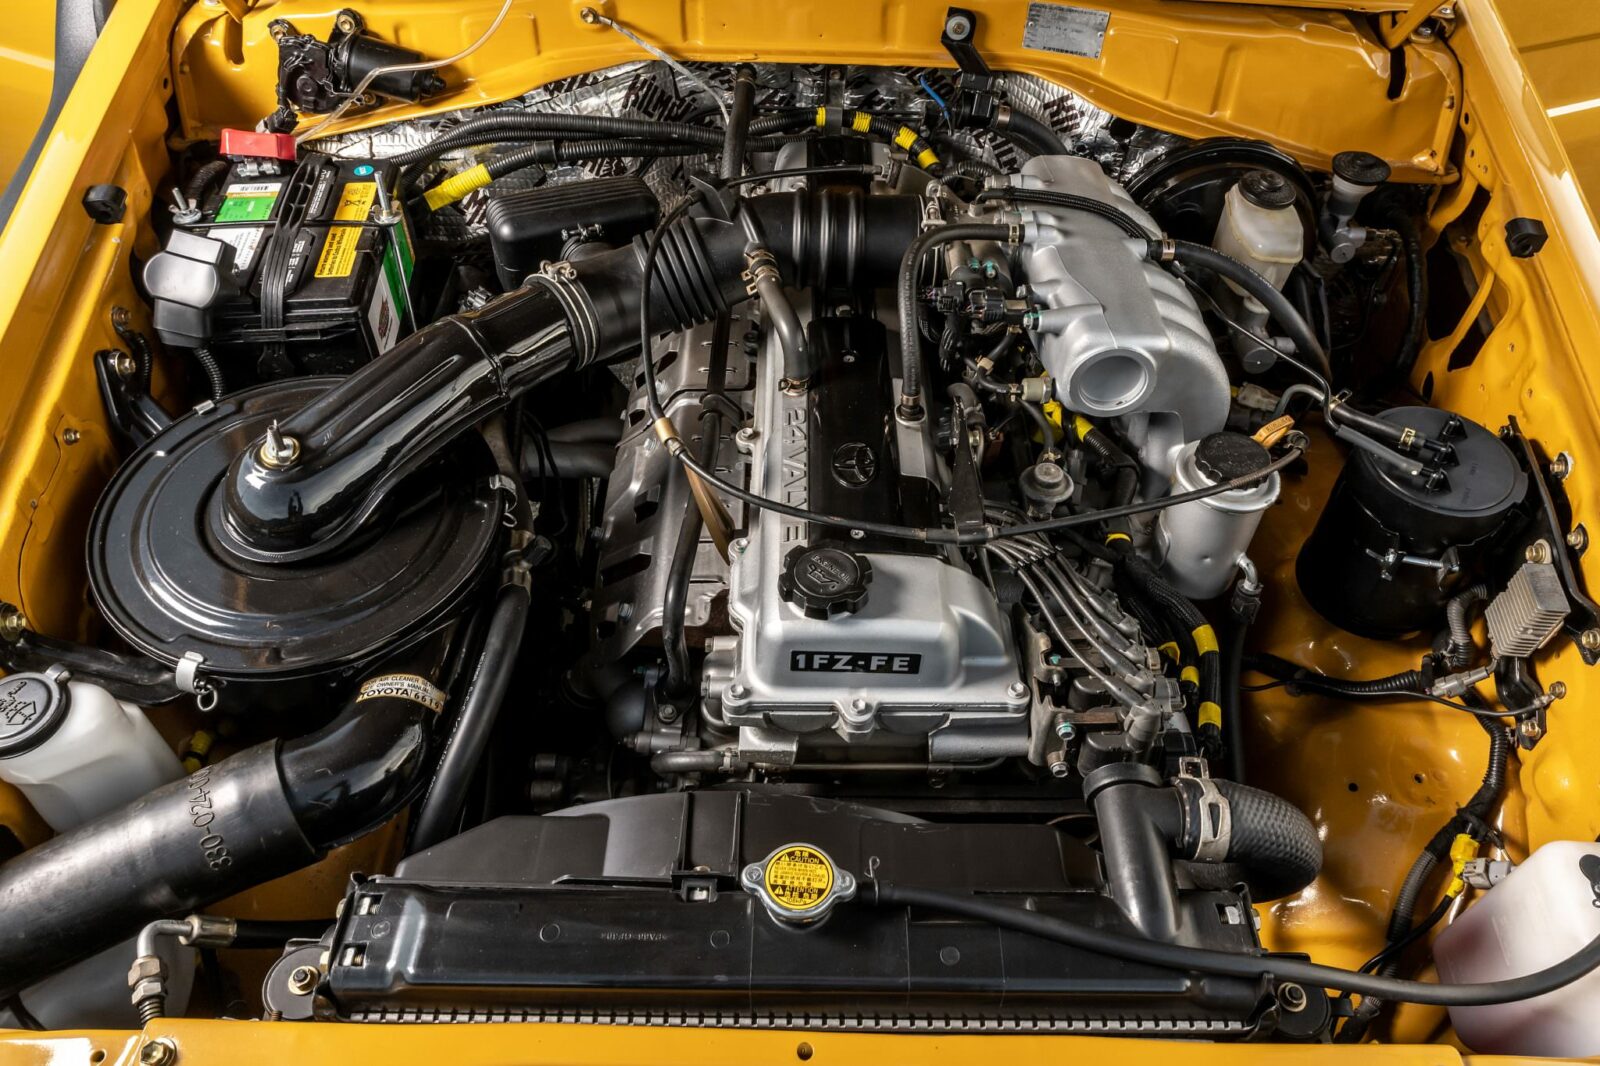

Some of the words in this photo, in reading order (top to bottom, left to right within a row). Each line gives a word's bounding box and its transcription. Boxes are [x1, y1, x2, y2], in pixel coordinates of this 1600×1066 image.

[796, 653, 911, 672] 1FZ-FE
[360, 687, 410, 699] TOYOTA
[786, 886, 819, 894] ATTENTION
